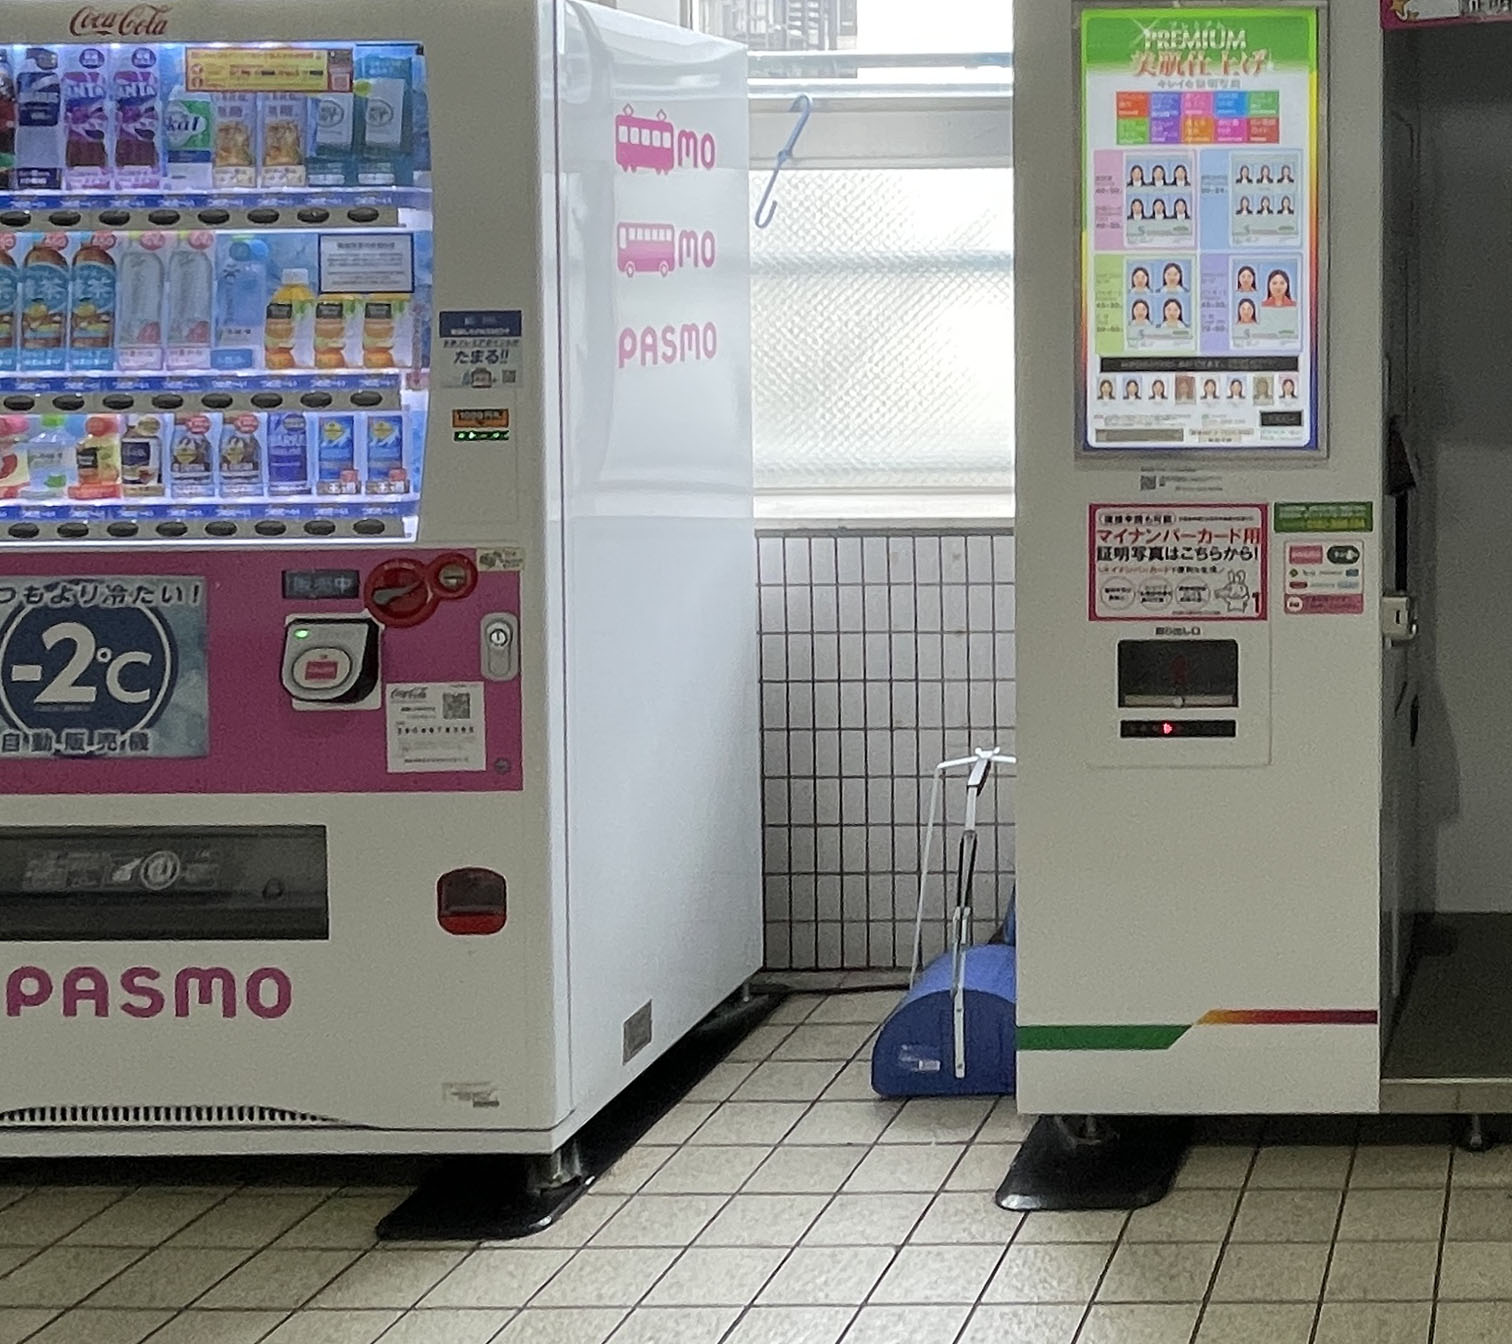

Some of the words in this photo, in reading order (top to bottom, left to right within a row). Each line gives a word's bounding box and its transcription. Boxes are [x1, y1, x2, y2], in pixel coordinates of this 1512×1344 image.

[70, 4, 173, 36] Coca-Cola
[1144, 29, 1246, 50] PREMIUM
[618, 321, 717, 368] PASMO
[1097, 527, 1261, 544] マイナンバーカード用
[1097, 545, 1258, 562] 証明写真はこちらから!
[6, 965, 292, 1019] PASMO
